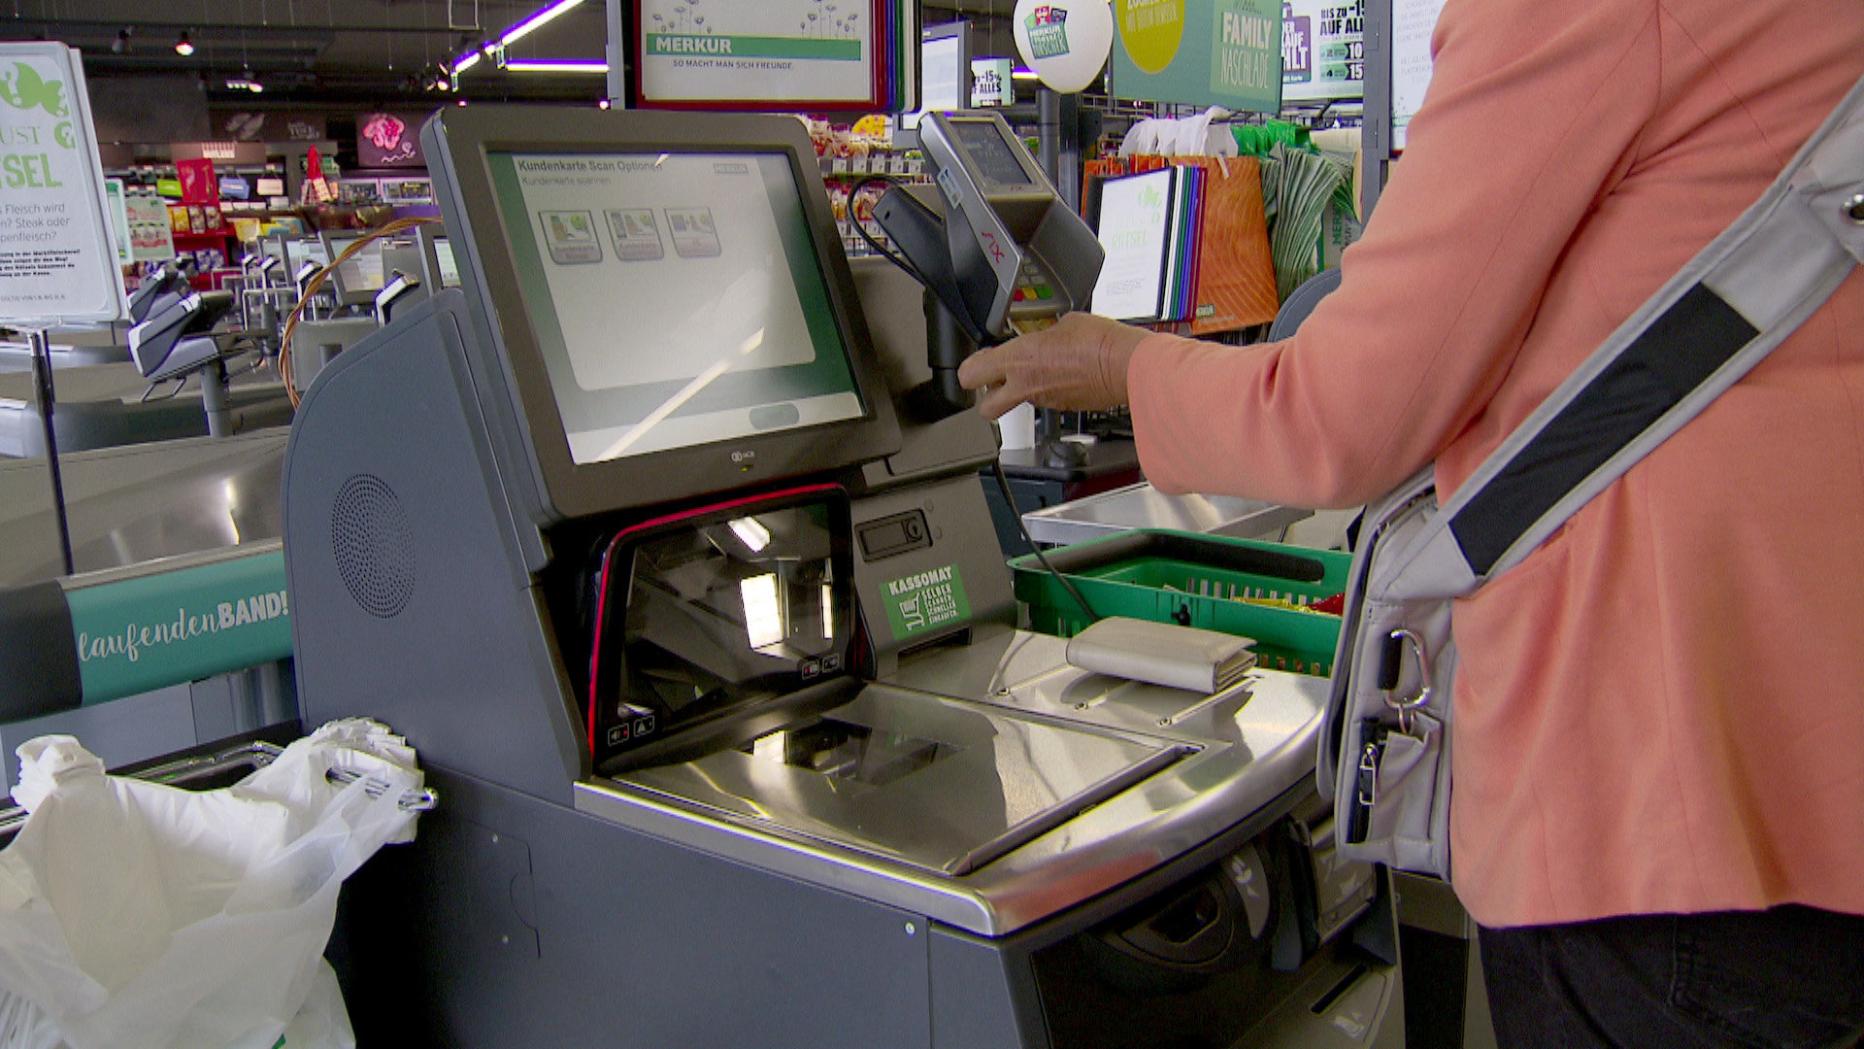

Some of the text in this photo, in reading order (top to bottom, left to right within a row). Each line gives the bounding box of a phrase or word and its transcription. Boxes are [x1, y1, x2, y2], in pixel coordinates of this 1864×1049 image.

[1222, 12, 1272, 49] FAMILY
[1320, 19, 1342, 36] AUF
[656, 36, 732, 54] MERKUR
[673, 60, 684, 68] SO
[685, 60, 713, 68] MACHT
[716, 61, 734, 69] MAN
[1221, 48, 1269, 89] NASCHLADE
[0, 153, 63, 189] SEL
[519, 160, 587, 172] Kundenkarte
[589, 160, 615, 171] Scan
[5, 202, 65, 215] Fleisch wird
[15, 216, 43, 229] Steak
[46, 216, 71, 226] oder
[888, 565, 952, 596] KASSOMAT
